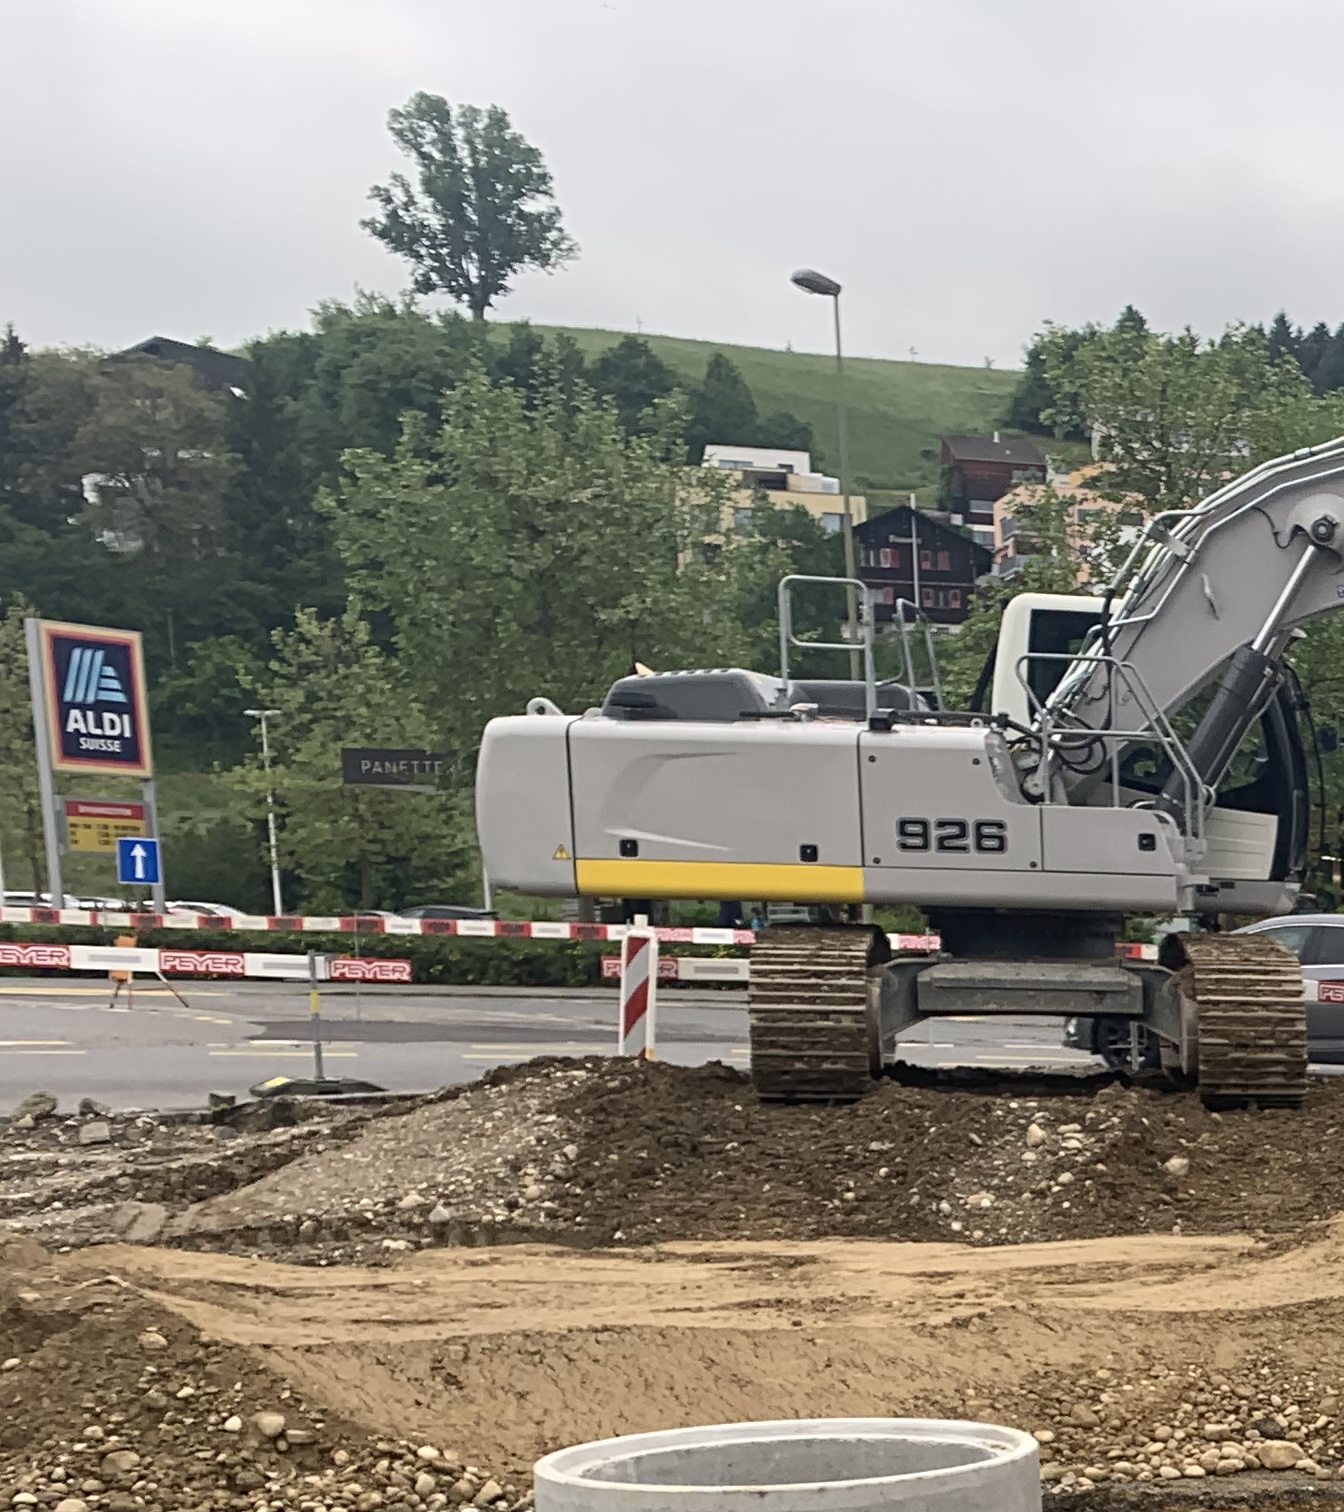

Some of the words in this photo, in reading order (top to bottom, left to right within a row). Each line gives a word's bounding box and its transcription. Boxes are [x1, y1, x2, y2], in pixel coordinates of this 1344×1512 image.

[66, 709, 132, 738] ALDI
[79, 737, 122, 753] SUISSE
[896, 817, 1008, 855] 926
[161, 952, 243, 974] PEYER
[331, 960, 411, 981] PEYER
